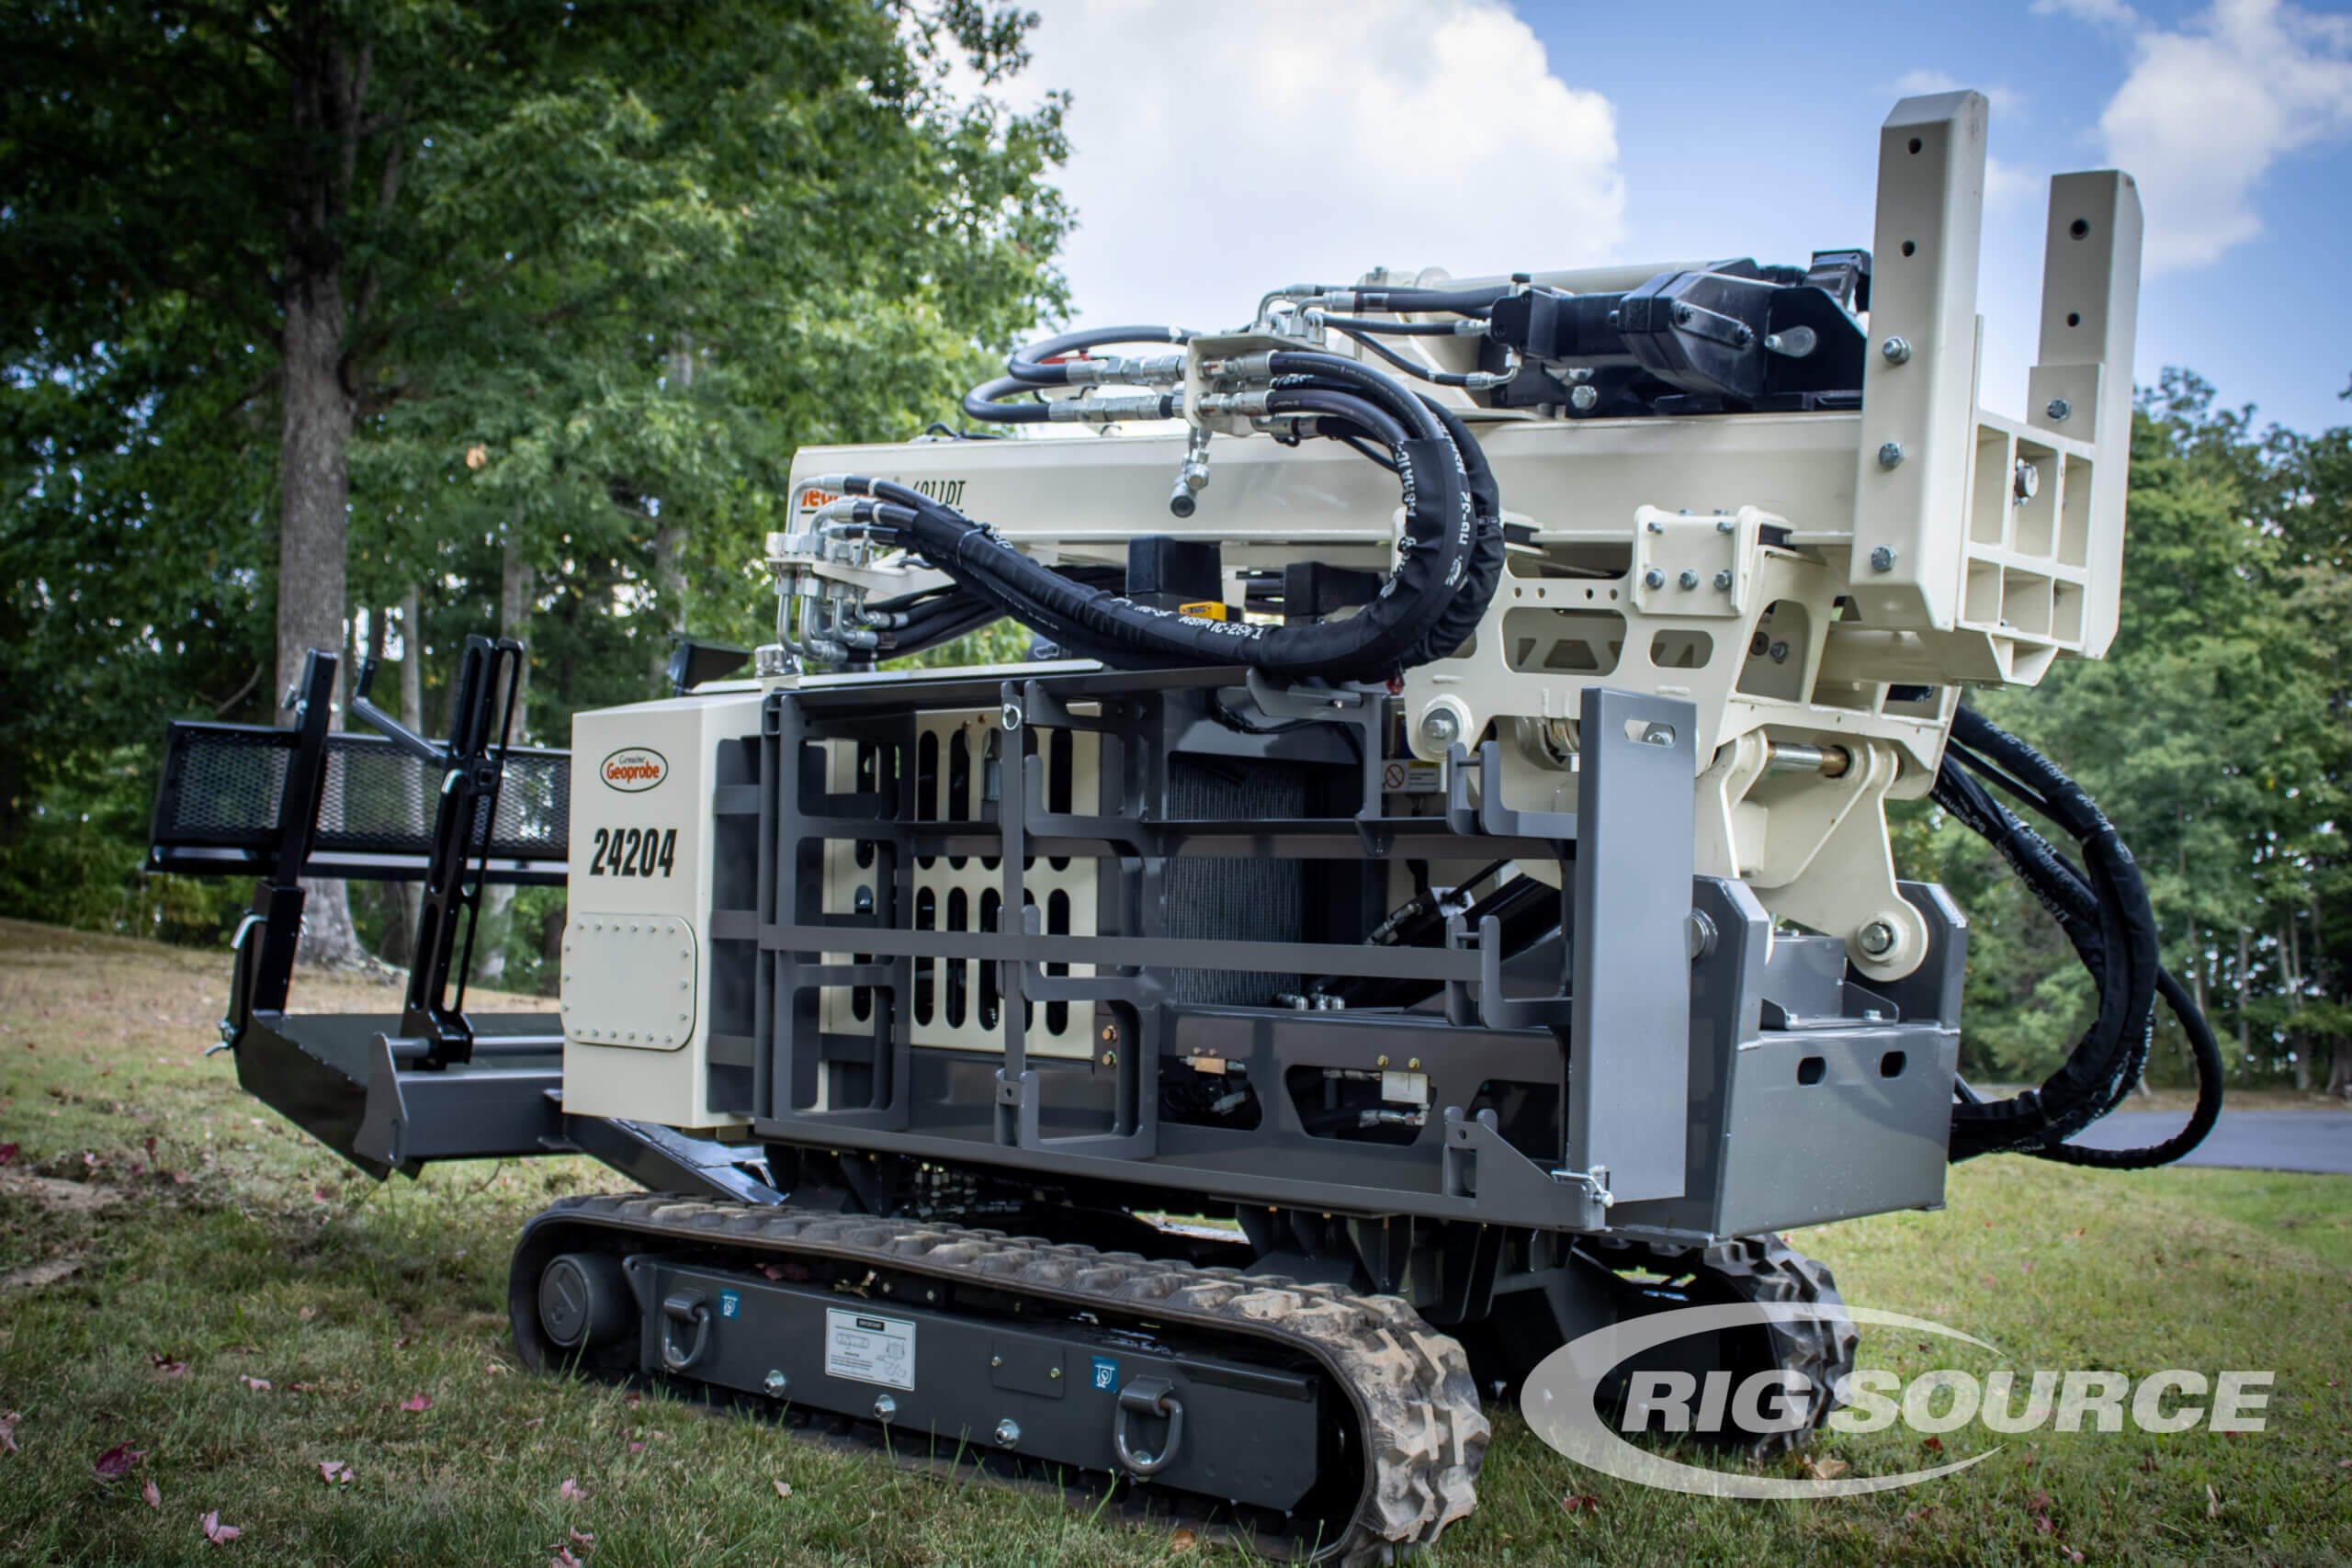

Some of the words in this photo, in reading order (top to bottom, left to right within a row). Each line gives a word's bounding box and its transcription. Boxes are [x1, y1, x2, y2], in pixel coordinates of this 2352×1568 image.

[913, 480, 967, 506] 011DT
[606, 760, 660, 784] Geoprobe
[589, 827, 677, 877] 24204
